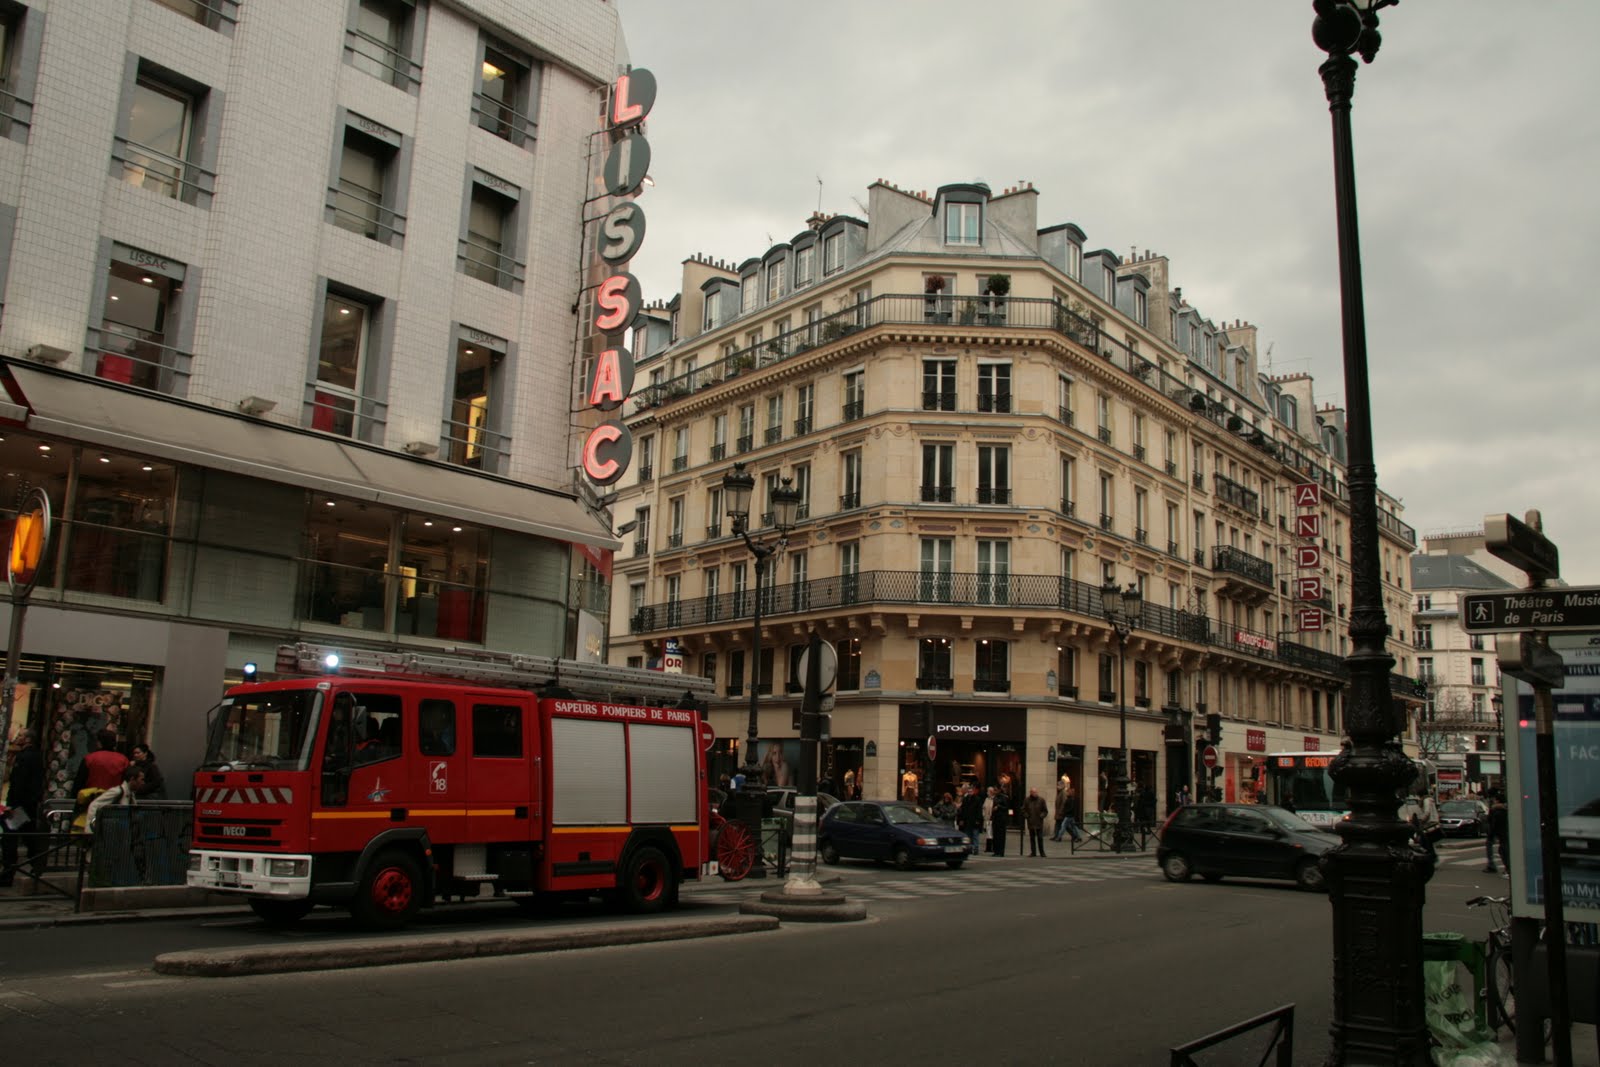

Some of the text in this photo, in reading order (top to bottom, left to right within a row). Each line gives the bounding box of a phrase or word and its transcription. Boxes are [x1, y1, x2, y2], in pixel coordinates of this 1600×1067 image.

[359, 119, 388, 138] LISSAC
[483, 174, 509, 192] LISSAC
[130, 250, 168, 270] LISSAC
[583, 76, 642, 479] LISSAC
[1503, 597, 1554, 610] Théâtre
[1504, 610, 1565, 624] de Paris
[665, 658, 682, 669] OR
[554, 701, 691, 722] SAPEURS POMPIERS DE PARIS
[936, 724, 990, 733] promod
[434, 778, 447, 791] 18
[223, 826, 246, 836] IVECO
